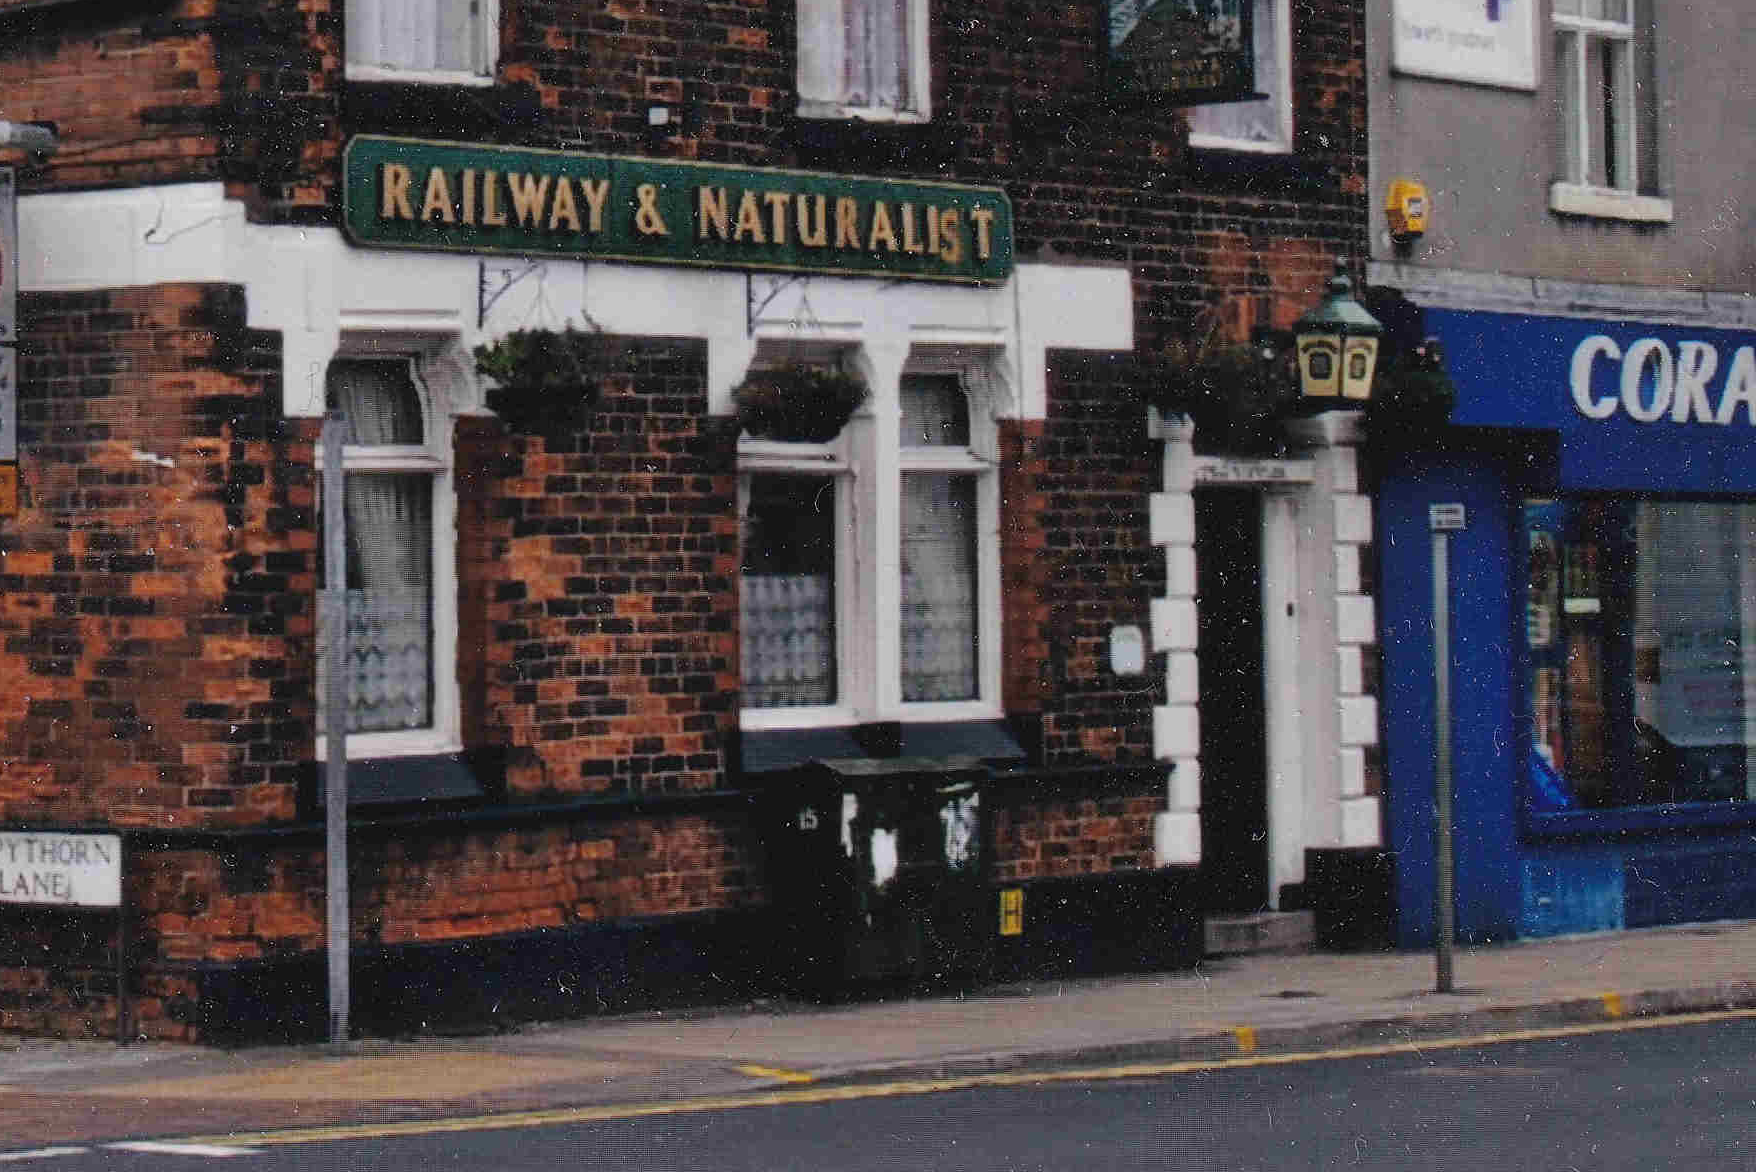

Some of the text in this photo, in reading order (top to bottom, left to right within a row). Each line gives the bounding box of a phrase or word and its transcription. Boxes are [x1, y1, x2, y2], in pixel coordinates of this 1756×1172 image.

[382, 163, 994, 264] RAILWAY & NATURALIST
[1570, 334, 1756, 426] CORA
[0, 870, 65, 898] LANE
